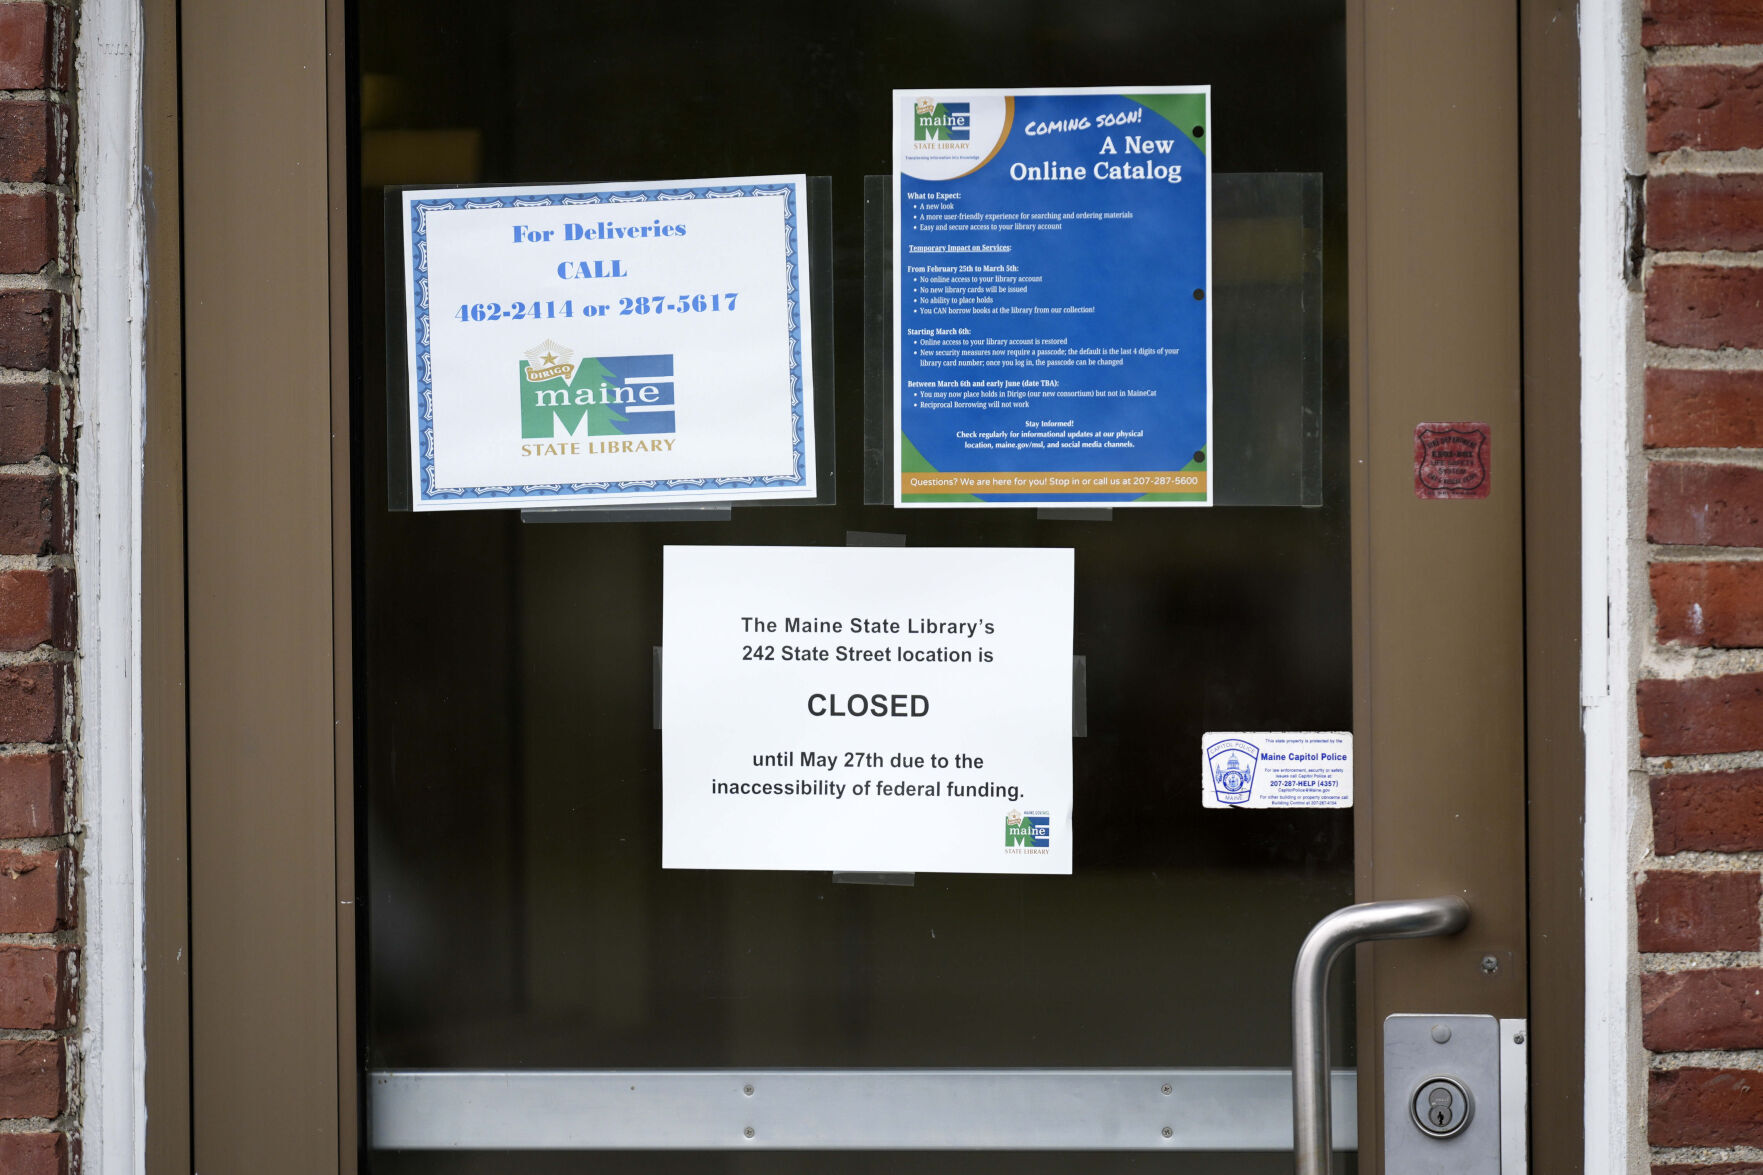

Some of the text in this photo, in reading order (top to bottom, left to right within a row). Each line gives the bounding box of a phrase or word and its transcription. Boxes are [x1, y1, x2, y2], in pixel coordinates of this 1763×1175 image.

[920, 115, 965, 126] maine
[1025, 107, 1143, 136] COMING SOON!
[1099, 136, 1174, 154] A New
[1010, 161, 1181, 182] Online Catalog
[936, 192, 961, 200] Expect:
[943, 212, 984, 220] user-friendly
[1030, 212, 1061, 220] searching
[512, 220, 686, 243] For Deliveries
[981, 244, 1011, 252] Services:
[557, 260, 627, 279] CALL
[926, 265, 957, 273] February
[958, 296, 975, 305] place
[455, 293, 739, 322] 462-2414 or 287-5617
[1010, 306, 1032, 314] library
[907, 328, 934, 336] Starting
[985, 338, 1008, 346] library
[530, 366, 570, 380] DIRIGO
[986, 380, 1003, 388] early
[1005, 380, 1020, 388] June
[535, 382, 660, 407] maine
[919, 401, 952, 409] Reciprocal
[953, 401, 987, 409] Borrowing
[1025, 420, 1039, 428] Stay
[978, 431, 1008, 439] regularly
[1067, 430, 1093, 438] updates
[1115, 430, 1143, 438] physical
[521, 439, 676, 457] STATE LIBRARY
[910, 478, 958, 486] Questions?
[960, 478, 974, 486] We
[992, 478, 1012, 486] here
[1014, 477, 1027, 485] for
[1029, 478, 1048, 487] you!
[1049, 477, 1070, 486] Stop
[1072, 477, 1080, 485] in
[1093, 477, 1108, 485] call
[741, 617, 776, 632] The
[785, 617, 842, 632] Maine
[850, 618, 899, 633] State
[742, 645, 993, 662] 242 State Street location is
[808, 694, 928, 716] CLOSED
[753, 752, 983, 770] until May 27th due to the
[1288, 753, 1318, 761] Capitol
[712, 780, 1023, 801] inaccessibility of federal funding.
[1009, 826, 1046, 835] maine
